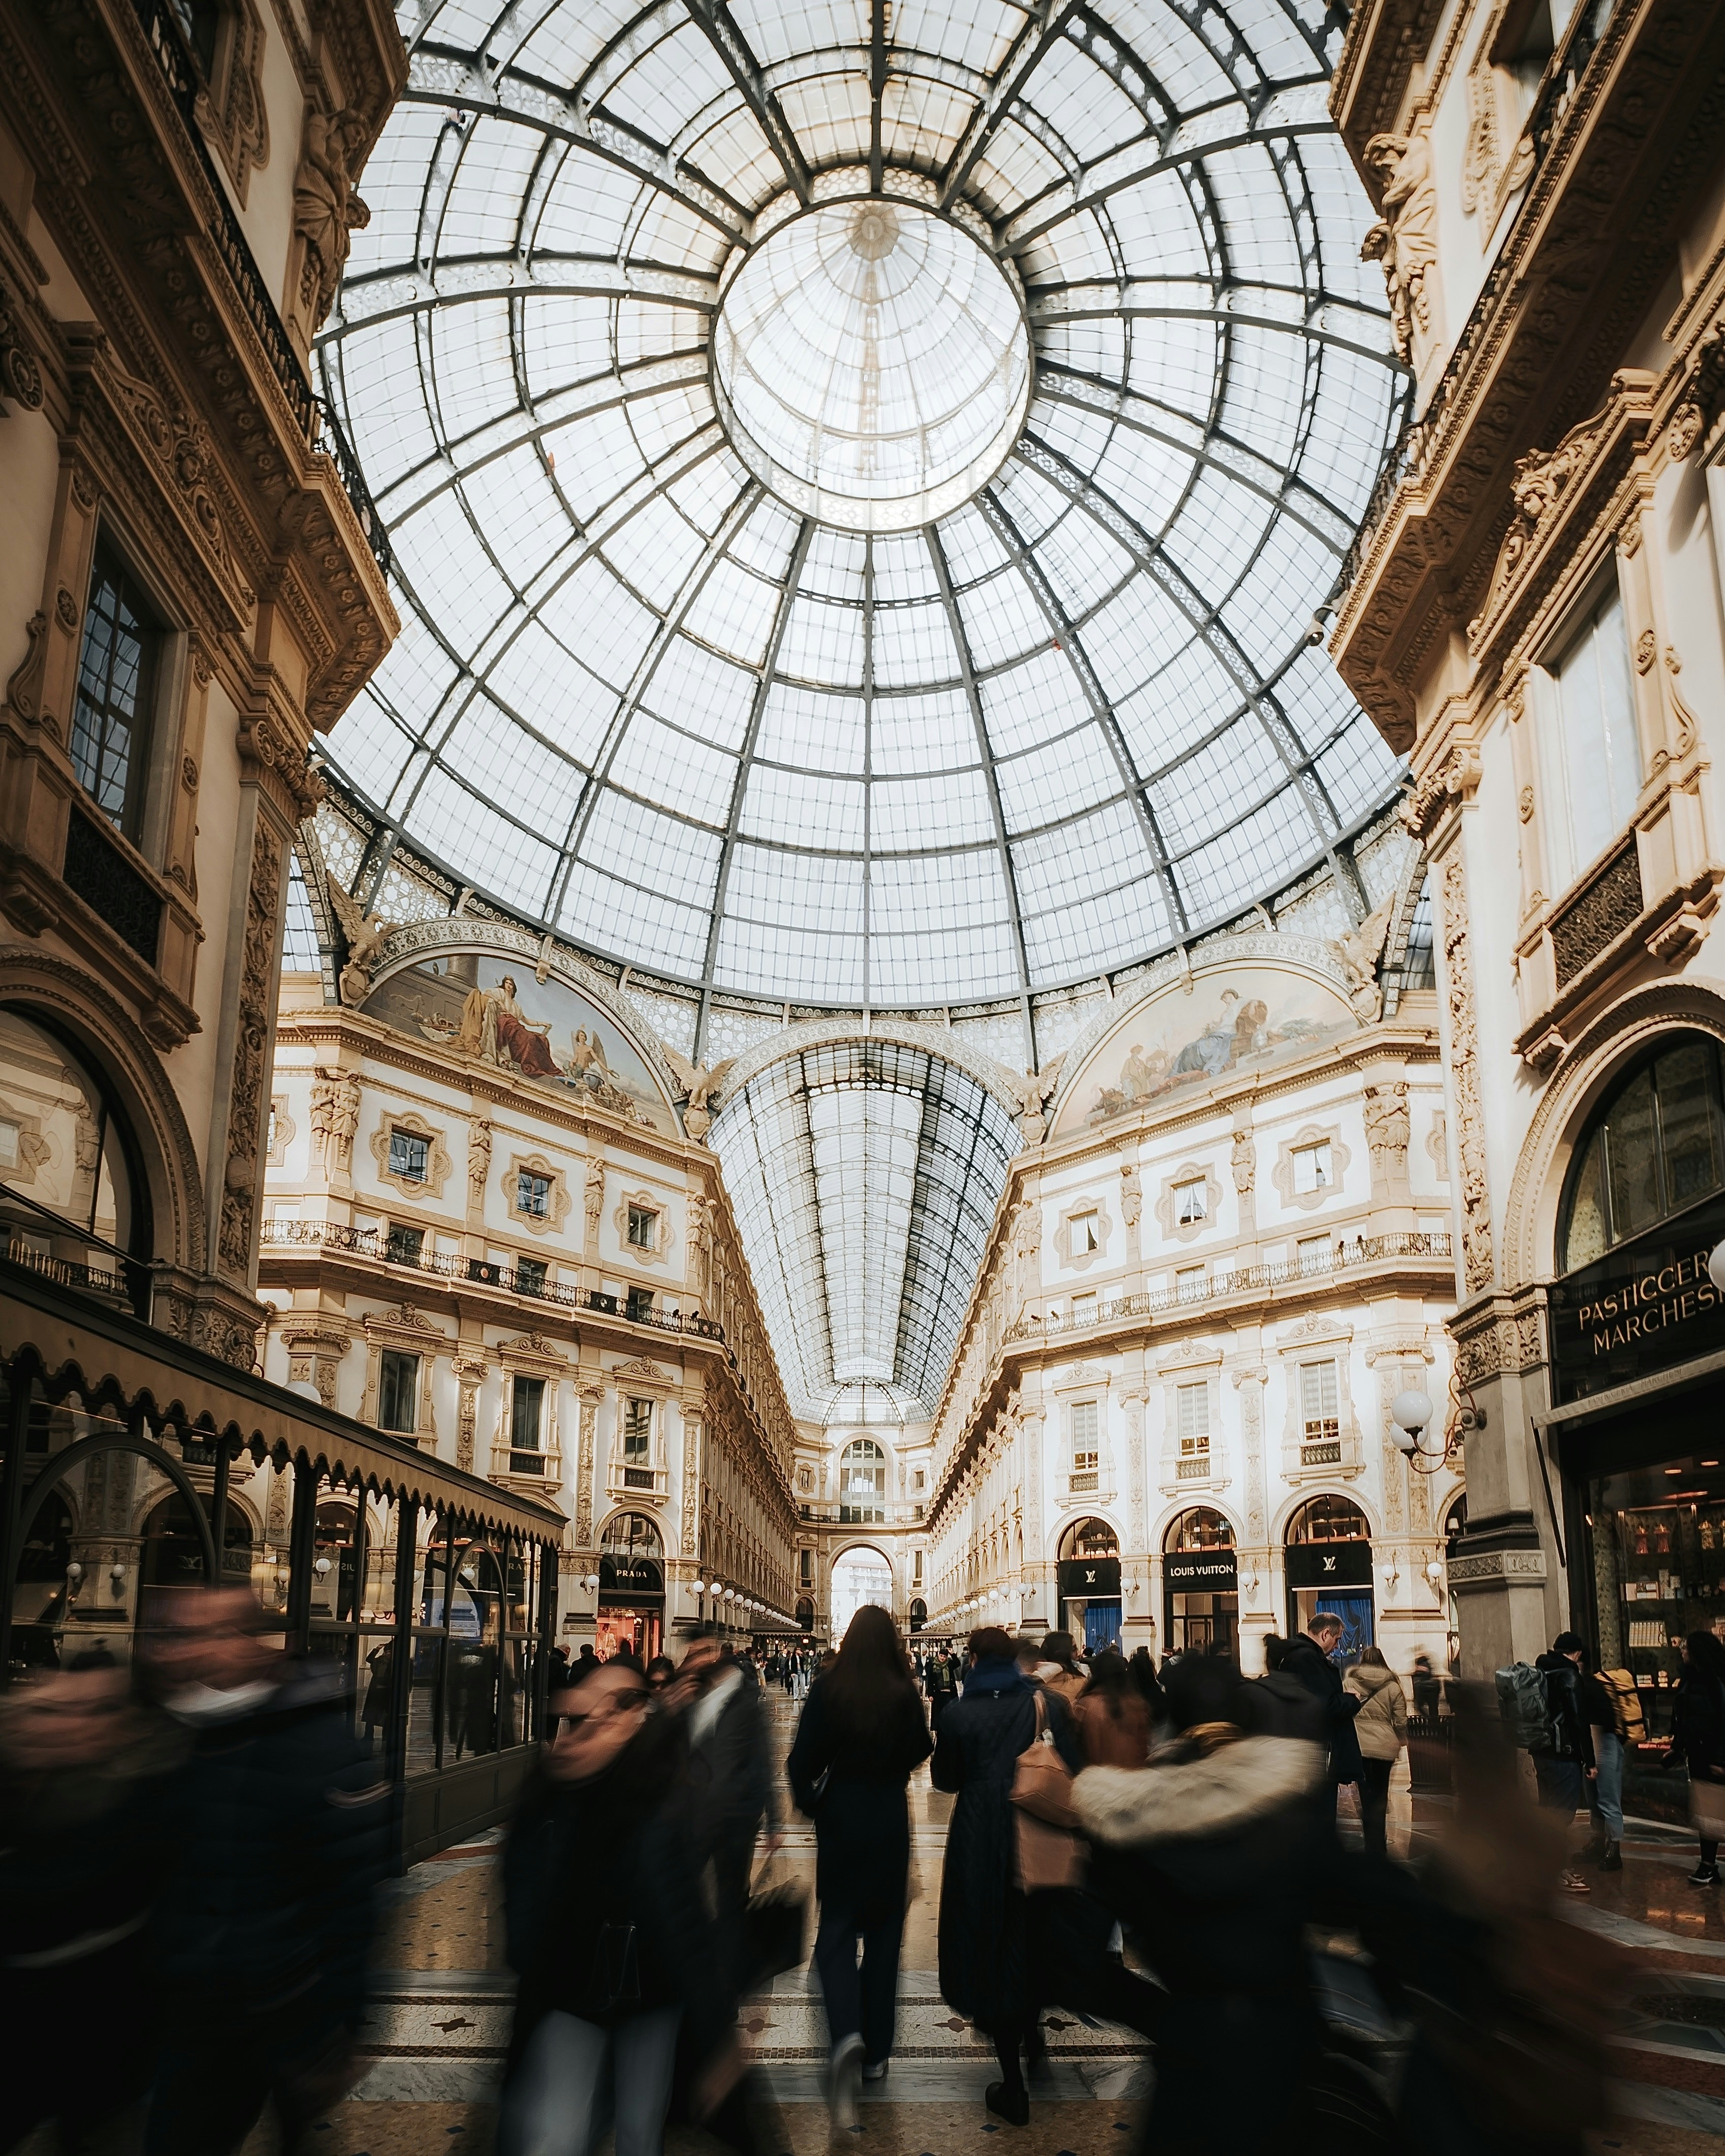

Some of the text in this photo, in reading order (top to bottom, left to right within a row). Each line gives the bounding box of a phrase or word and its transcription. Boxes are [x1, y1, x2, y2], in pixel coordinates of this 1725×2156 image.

[1579, 1245, 1716, 1331] PASTICCER
[616, 1569, 647, 1578] PRADA
[1170, 1565, 1233, 1576] LOUIS VUITTON
